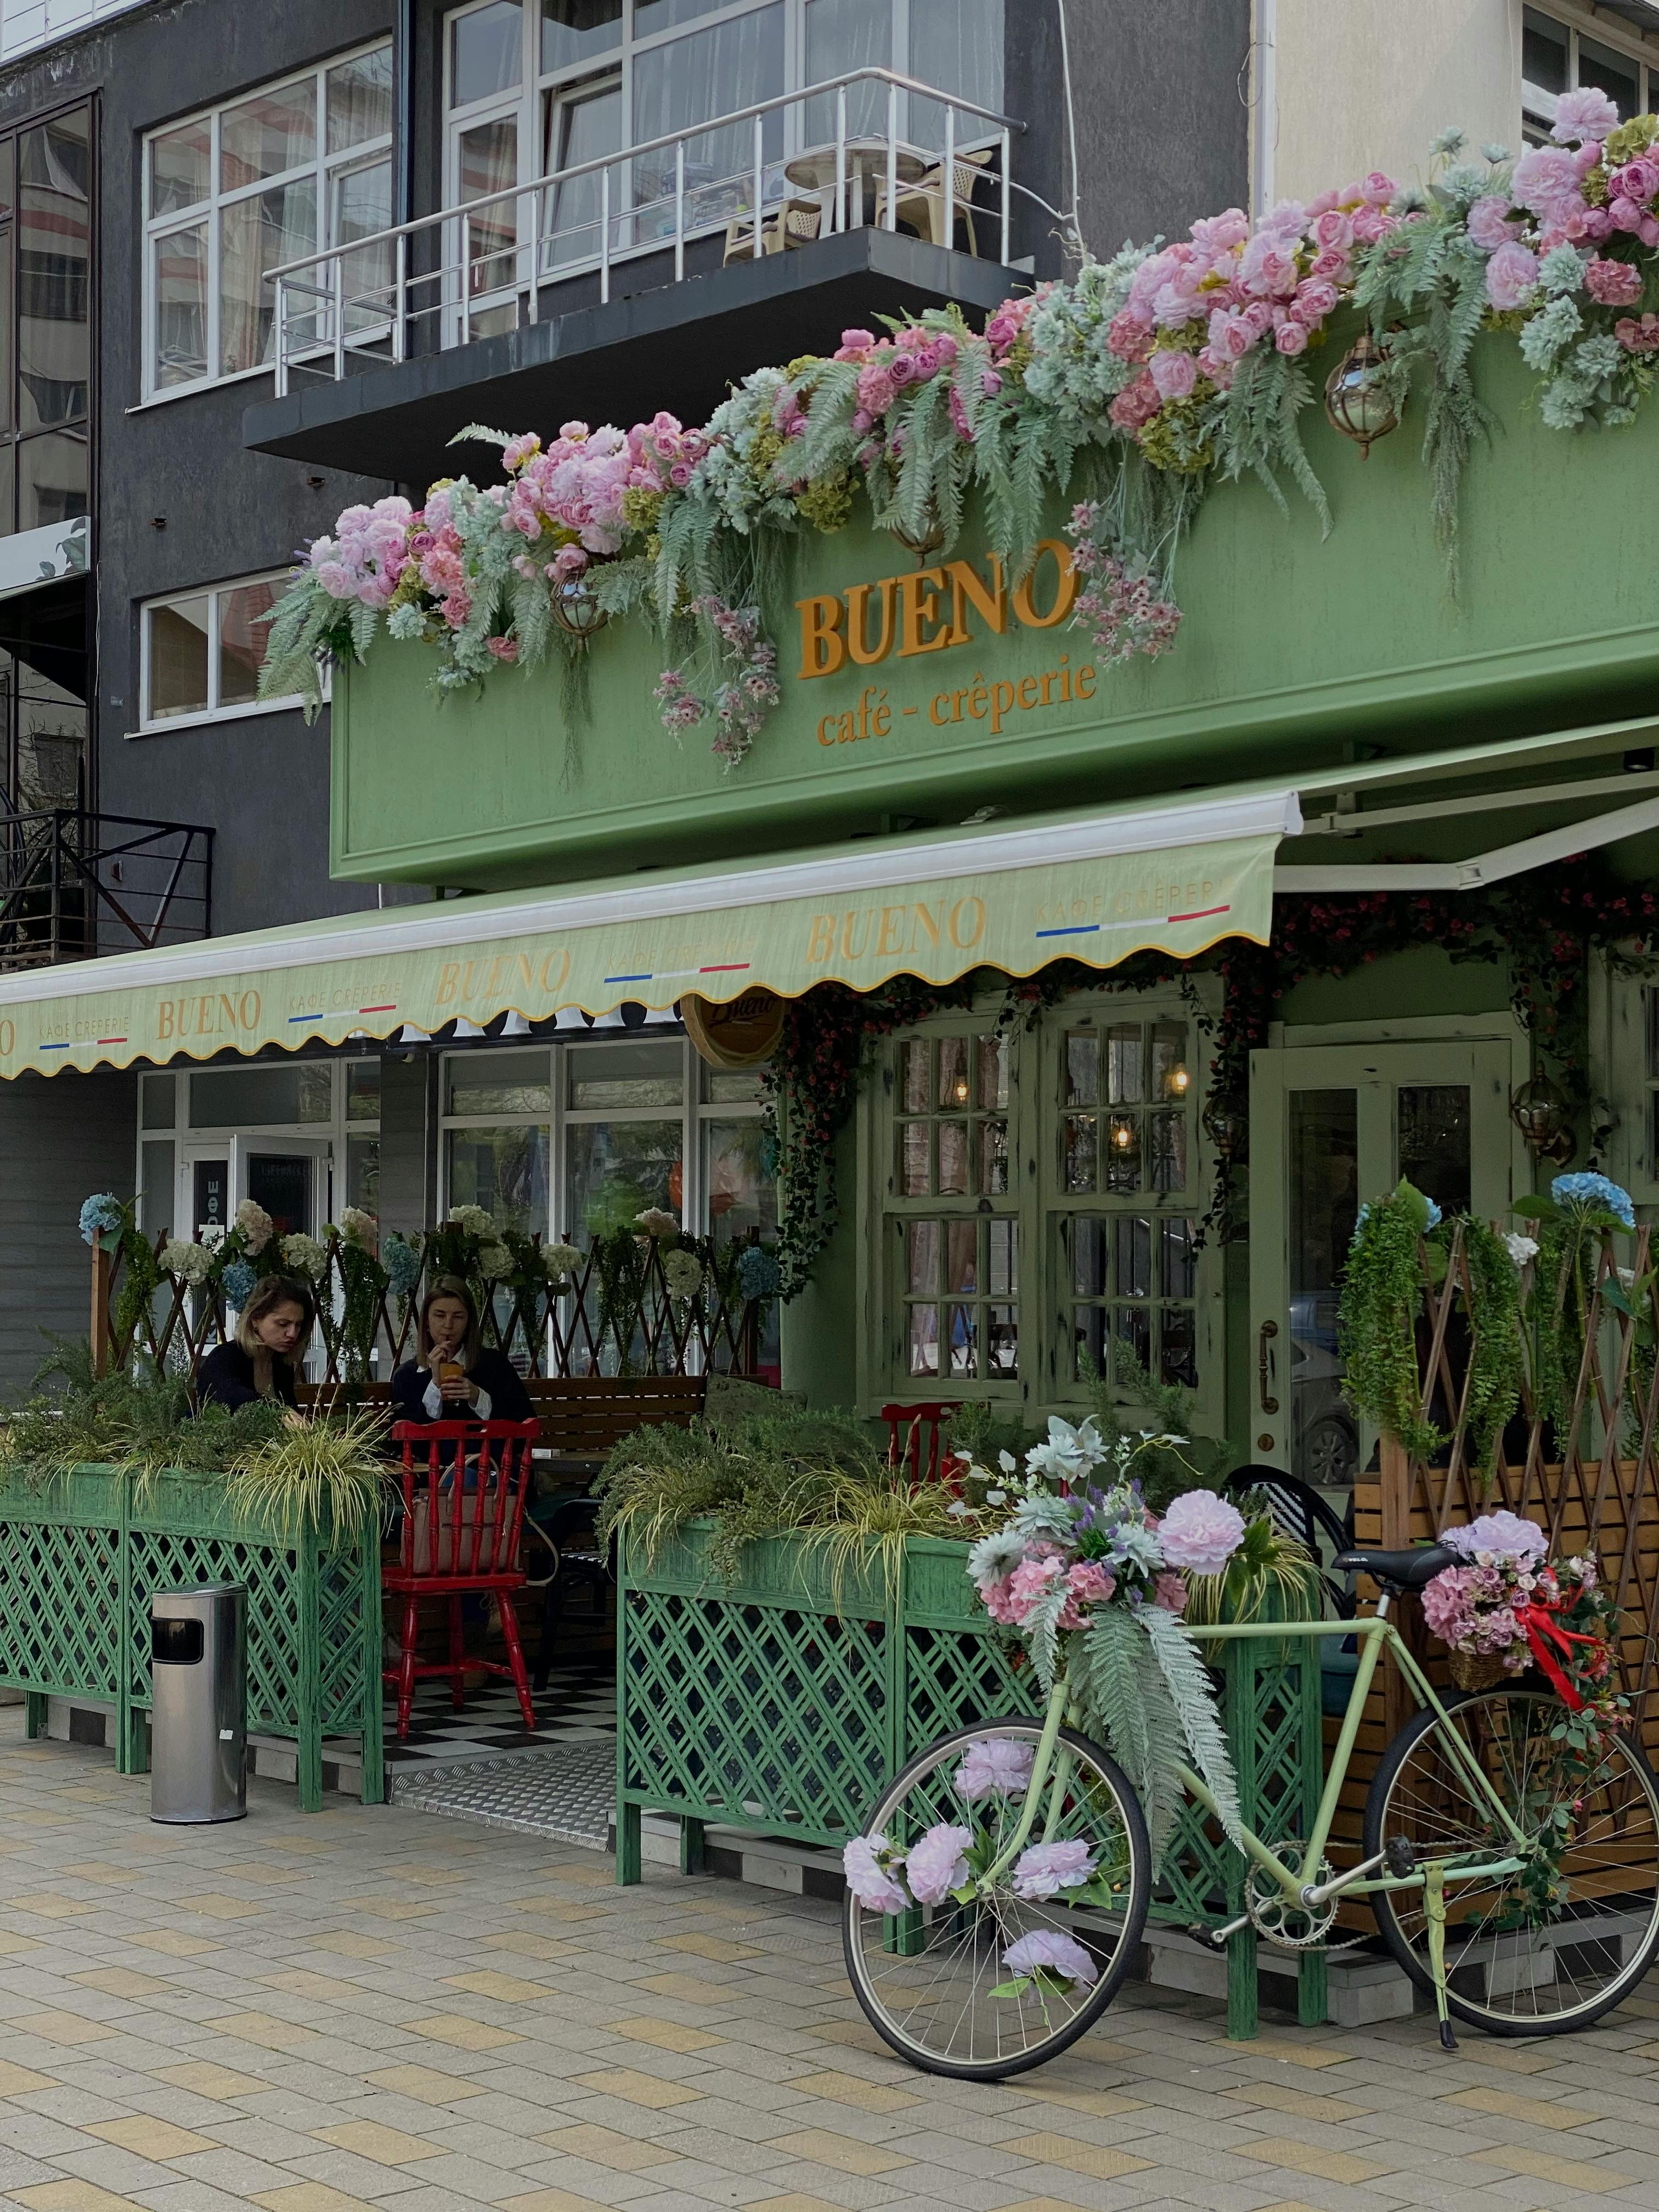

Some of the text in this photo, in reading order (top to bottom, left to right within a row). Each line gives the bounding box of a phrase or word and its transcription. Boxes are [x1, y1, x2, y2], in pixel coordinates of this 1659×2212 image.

[795, 538, 1082, 680] BUENO
[816, 686, 891, 746] café
[928, 654, 1097, 735] crêperie
[157, 989, 261, 1040] BUENO
[434, 948, 571, 1005] BUENO
[804, 895, 986, 964] BUENO
